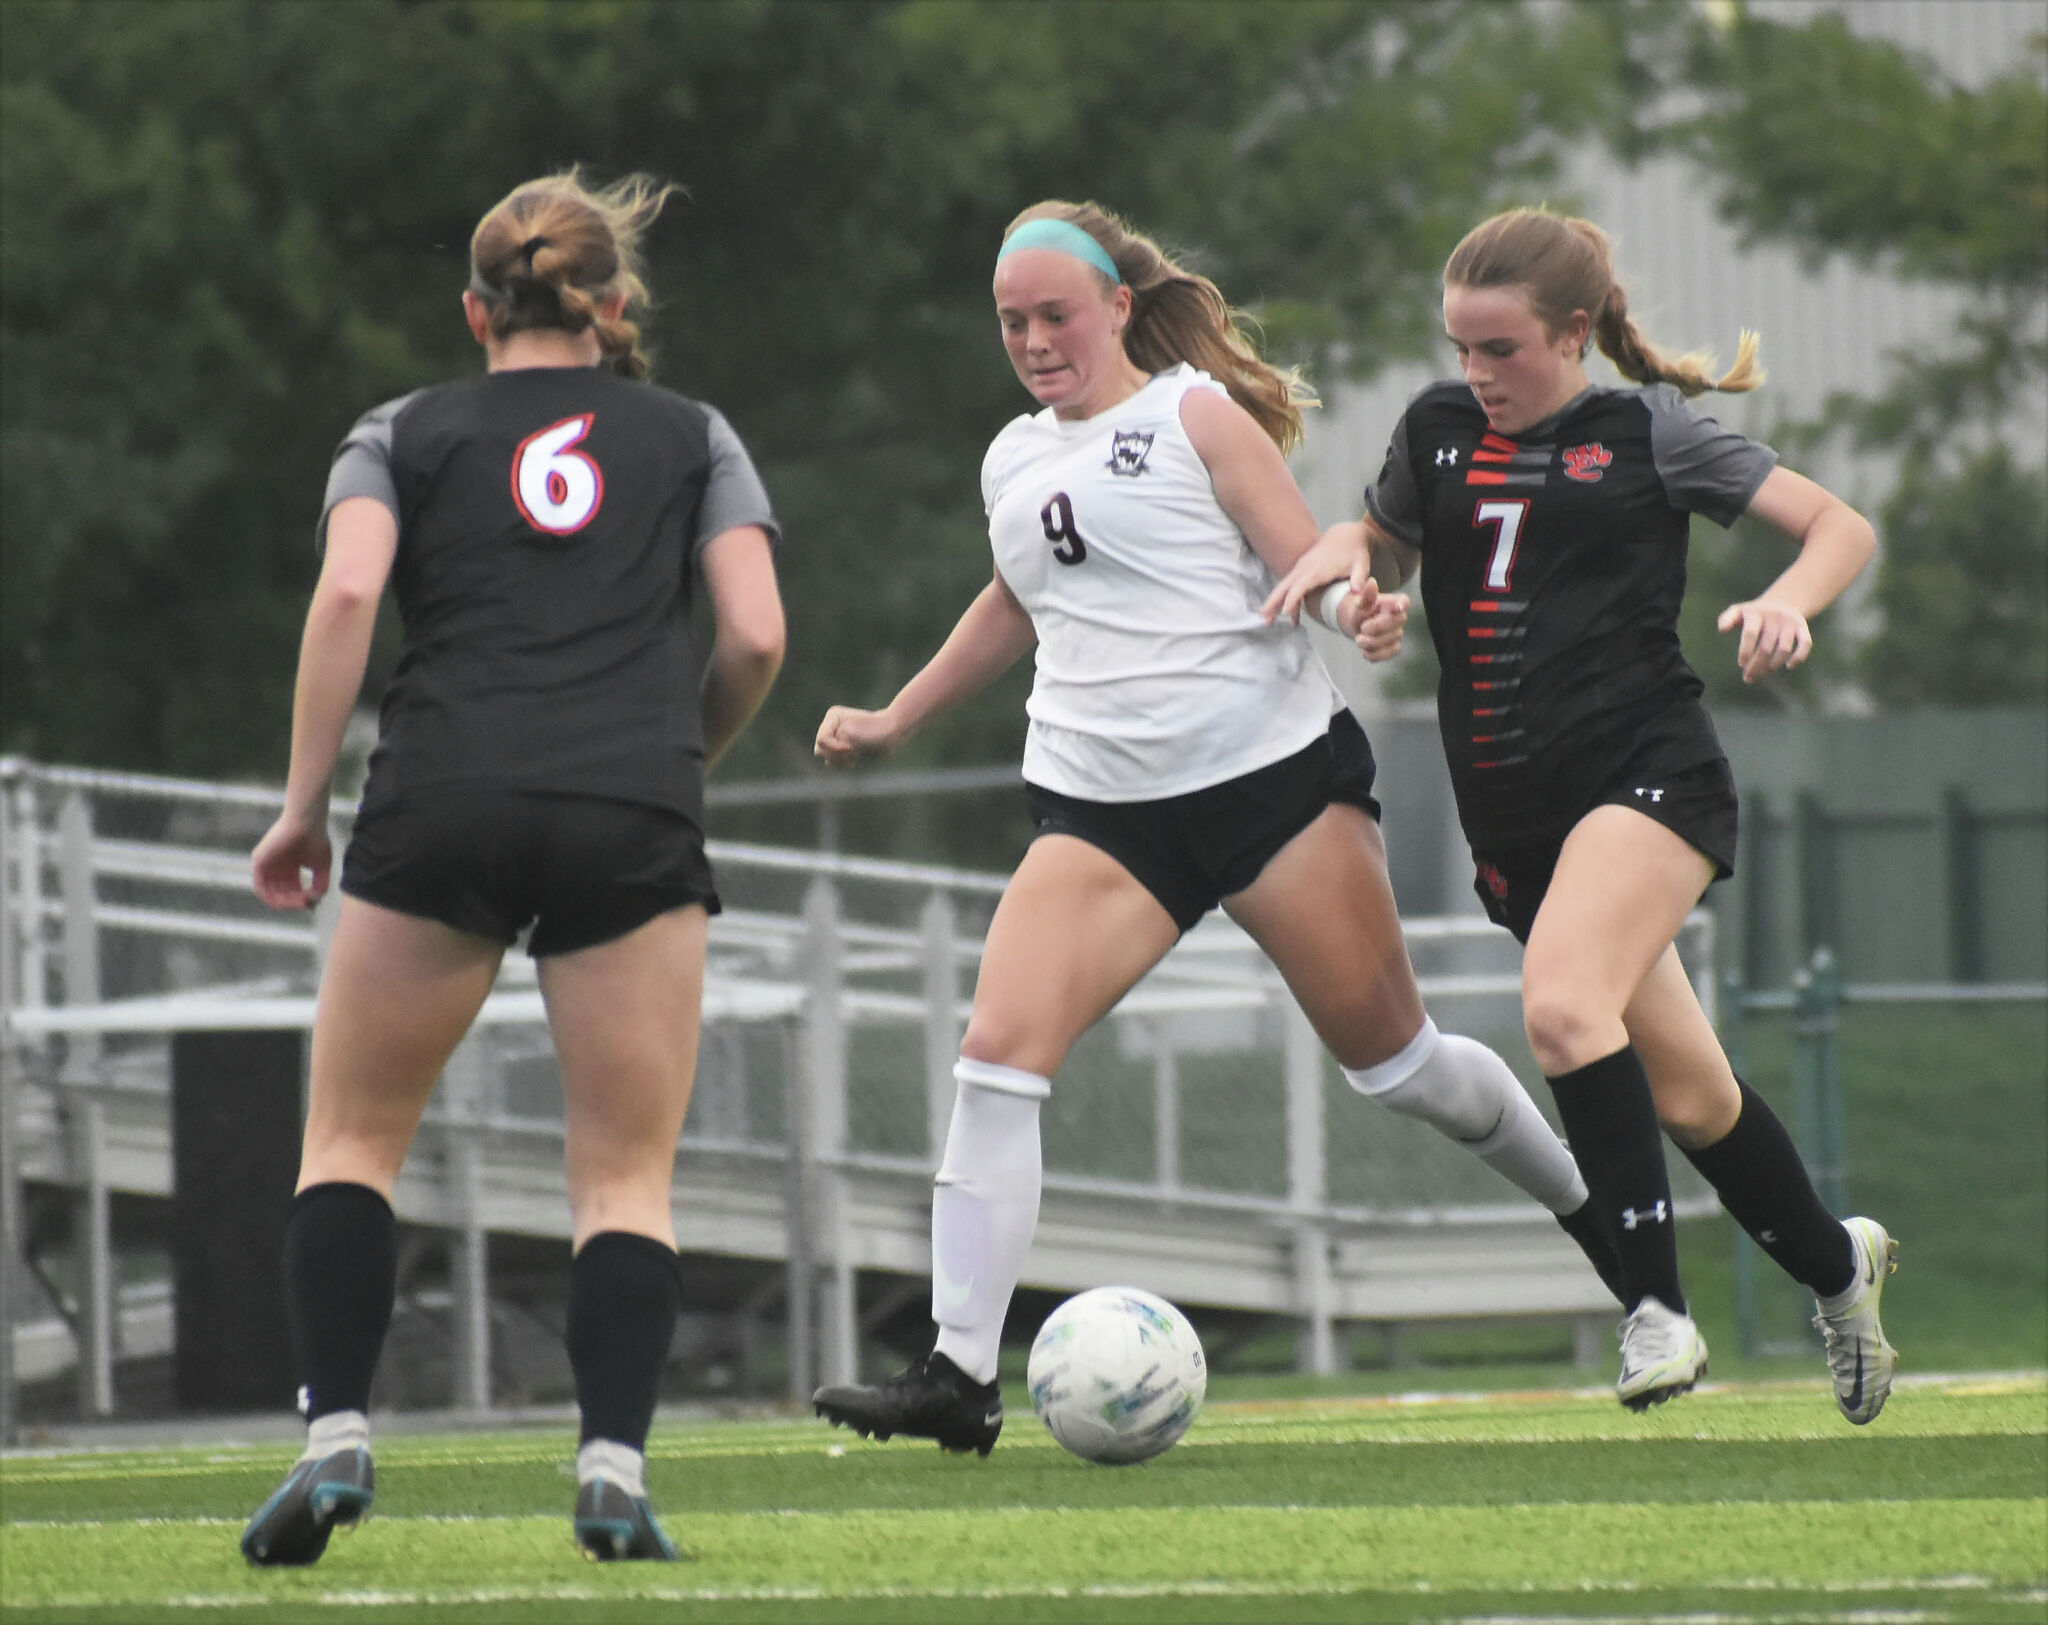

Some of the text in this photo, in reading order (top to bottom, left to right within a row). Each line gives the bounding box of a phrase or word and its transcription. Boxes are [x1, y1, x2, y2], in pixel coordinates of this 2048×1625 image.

[511, 412, 605, 536] 6
[1041, 491, 1086, 565] 9
[1472, 498, 1531, 592] 7
